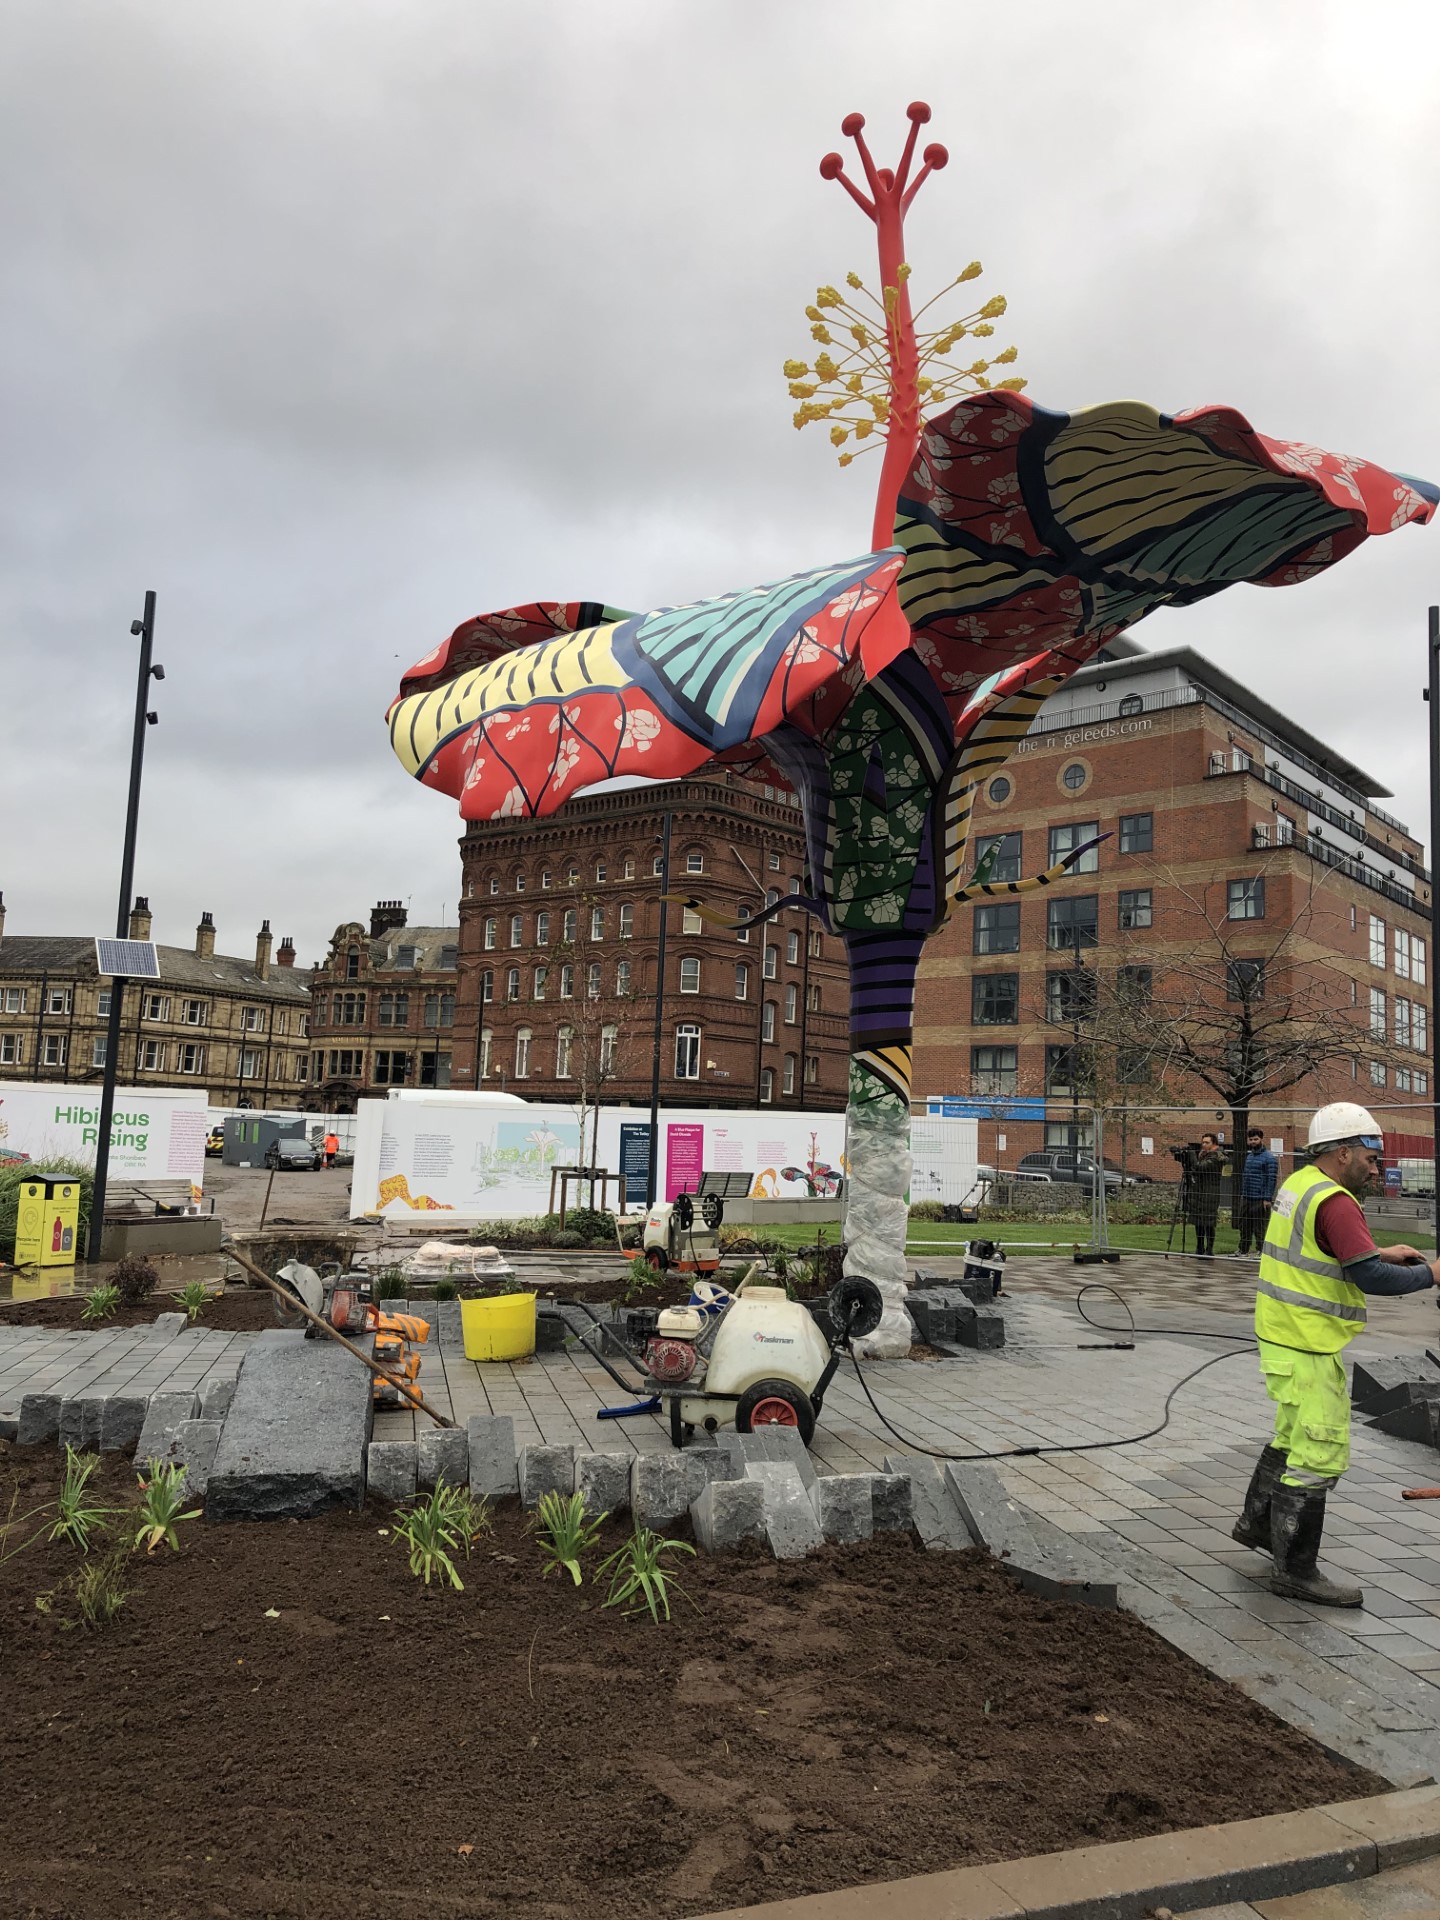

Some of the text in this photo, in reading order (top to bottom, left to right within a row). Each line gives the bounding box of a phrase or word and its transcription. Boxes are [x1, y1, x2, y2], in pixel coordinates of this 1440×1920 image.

[1018, 738, 1038, 754] the
[54, 1105, 150, 1126] Hibicus
[82, 1127, 149, 1152] Rsing
